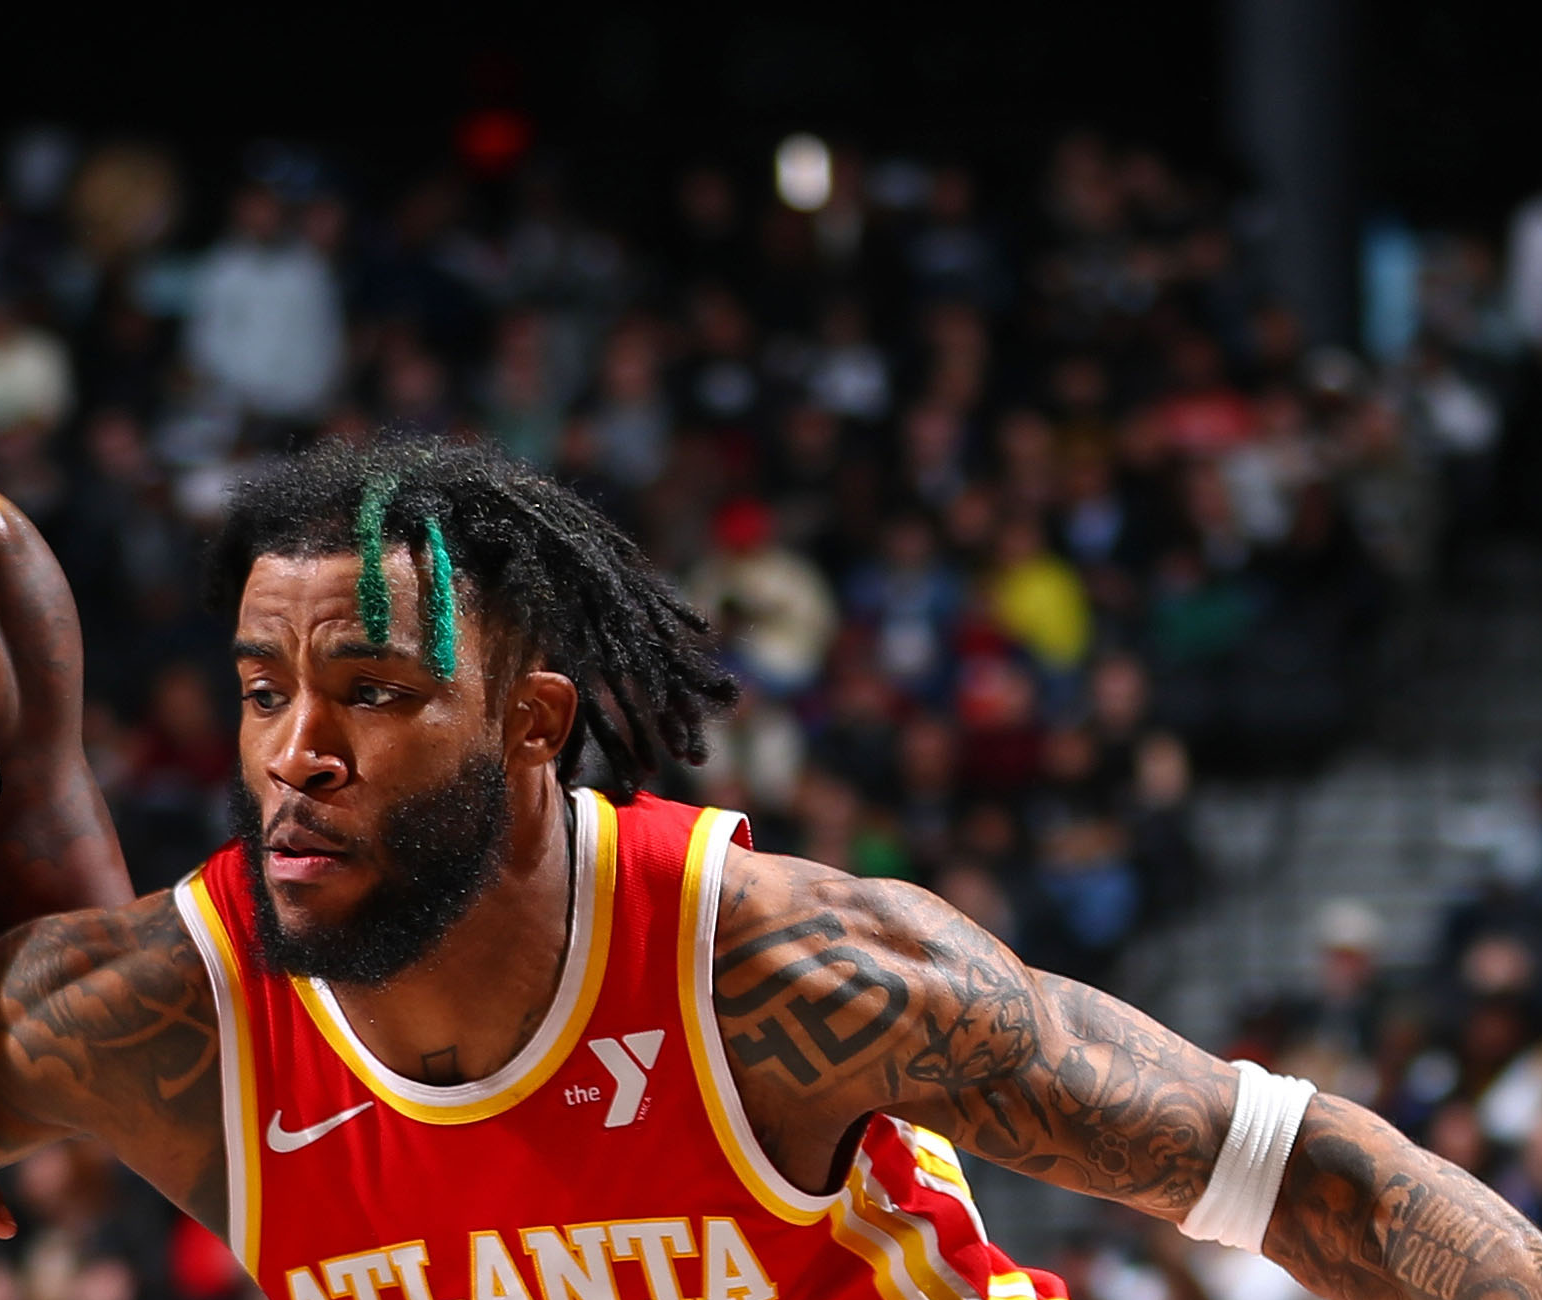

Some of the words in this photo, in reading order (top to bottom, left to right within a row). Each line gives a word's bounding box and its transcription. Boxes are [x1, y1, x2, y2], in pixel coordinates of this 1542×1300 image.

[563, 1084, 601, 1106] the
[637, 1096, 652, 1121] YMCA
[1414, 1194, 1509, 1264] DRAFT
